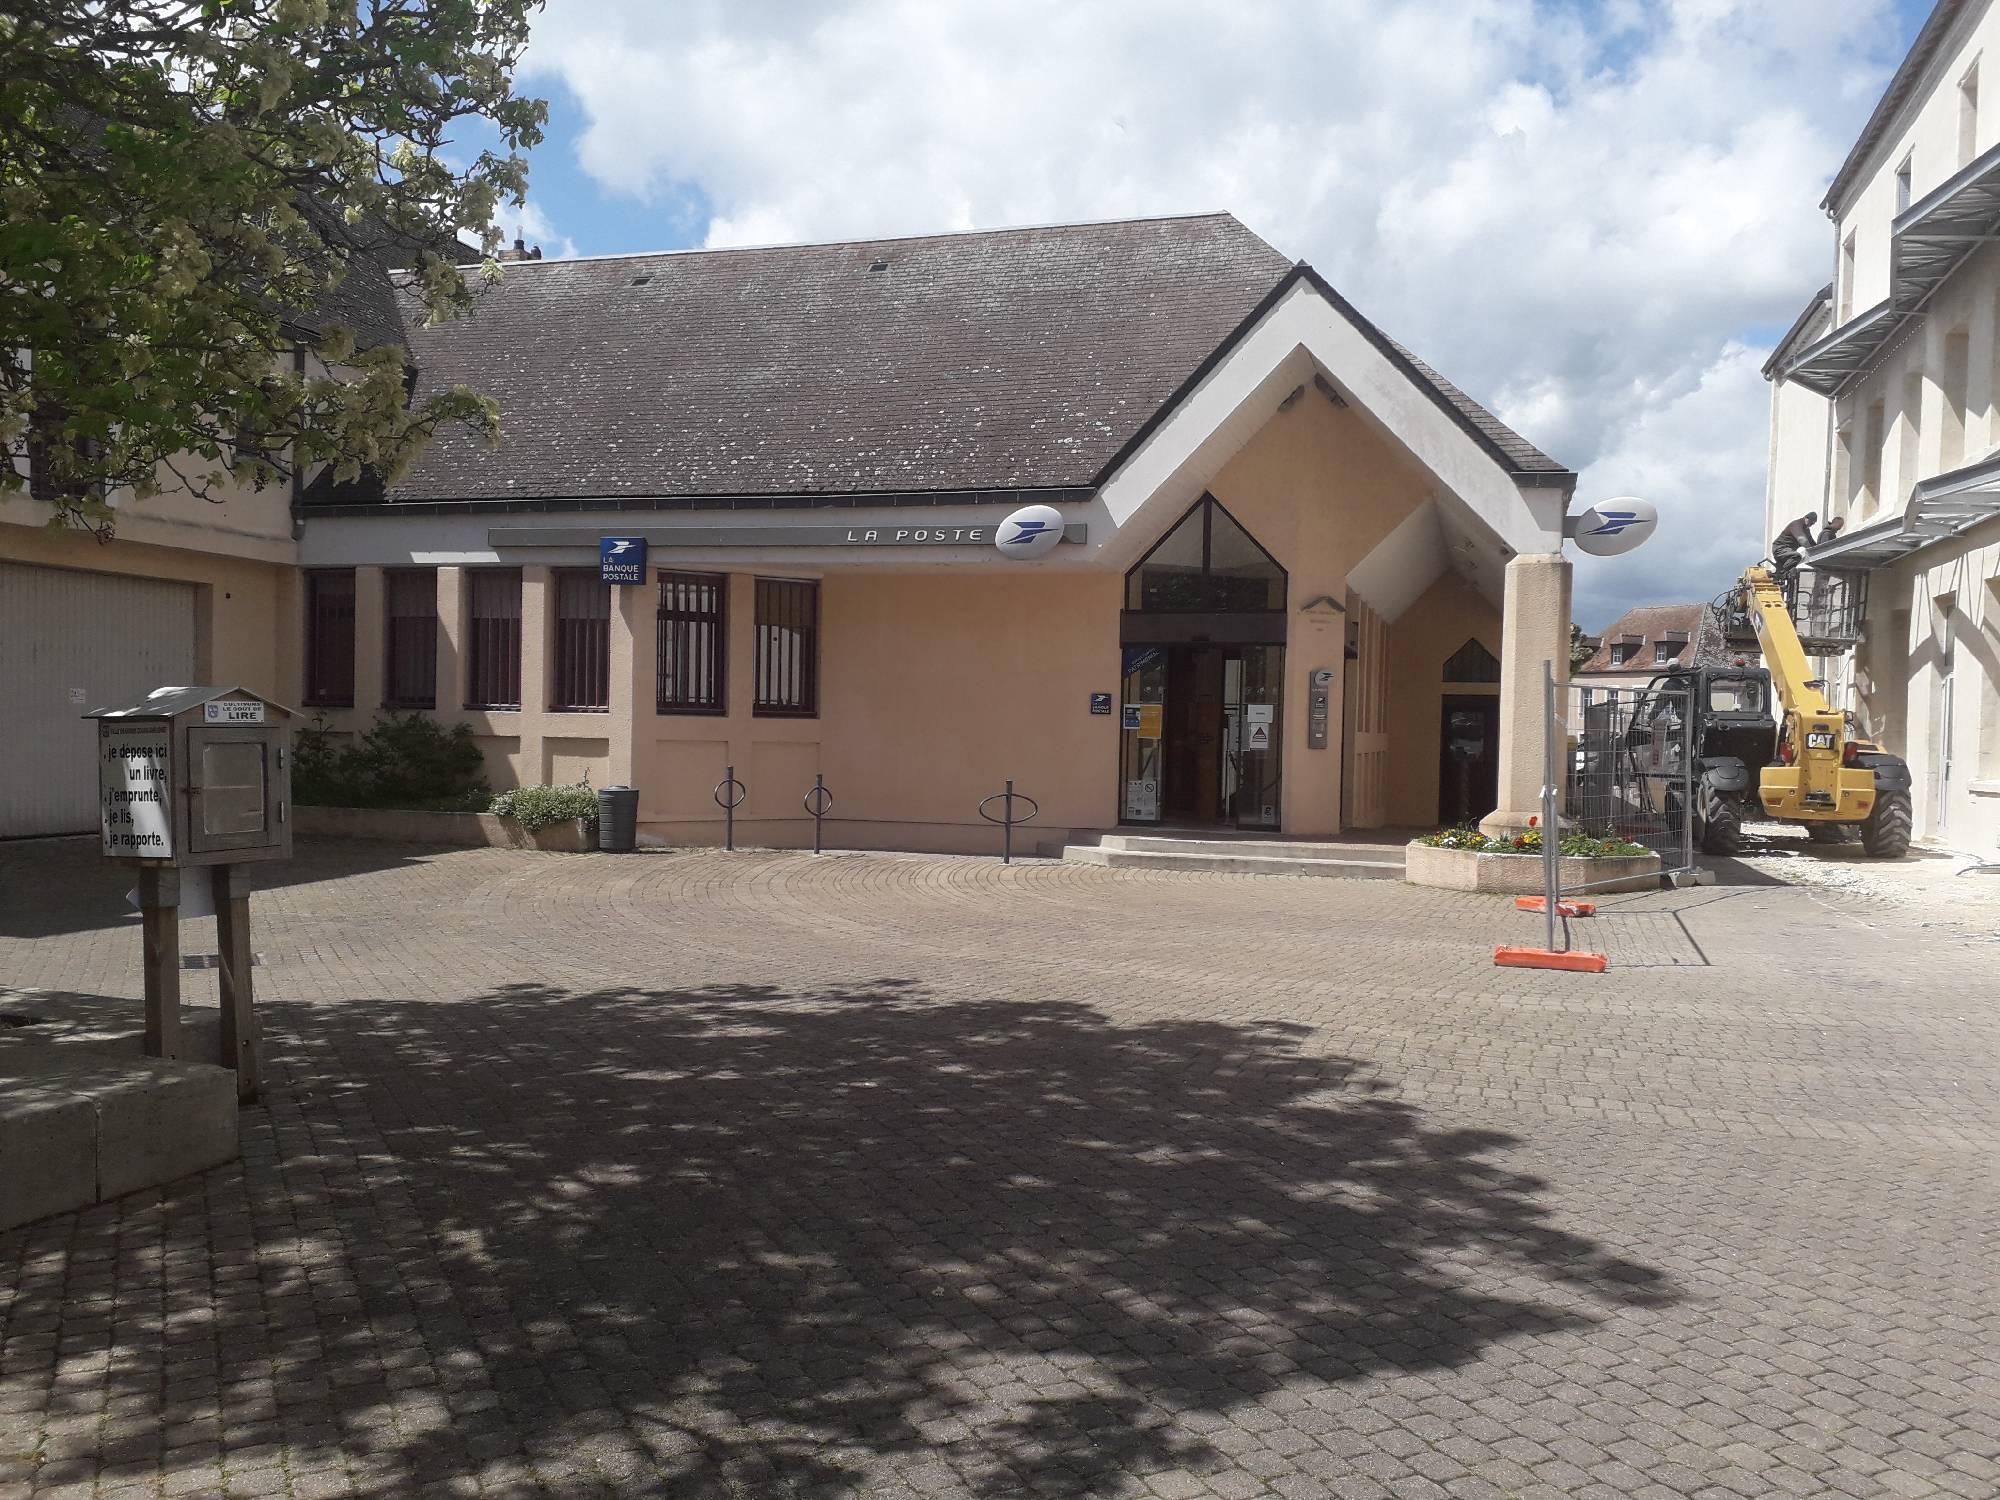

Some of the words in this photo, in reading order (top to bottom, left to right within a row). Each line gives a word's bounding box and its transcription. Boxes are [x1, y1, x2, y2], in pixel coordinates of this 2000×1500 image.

[847, 530, 878, 542] LA
[895, 529, 983, 541] POSTE
[603, 556, 614, 564] LA
[603, 564, 639, 573] BANQUE
[603, 573, 639, 581] POSTALE
[228, 712, 257, 720] LIRE
[1808, 733, 1833, 749] CAT
[119, 743, 153, 763] dépose
[155, 743, 168, 758] ici
[129, 768, 141, 781] un
